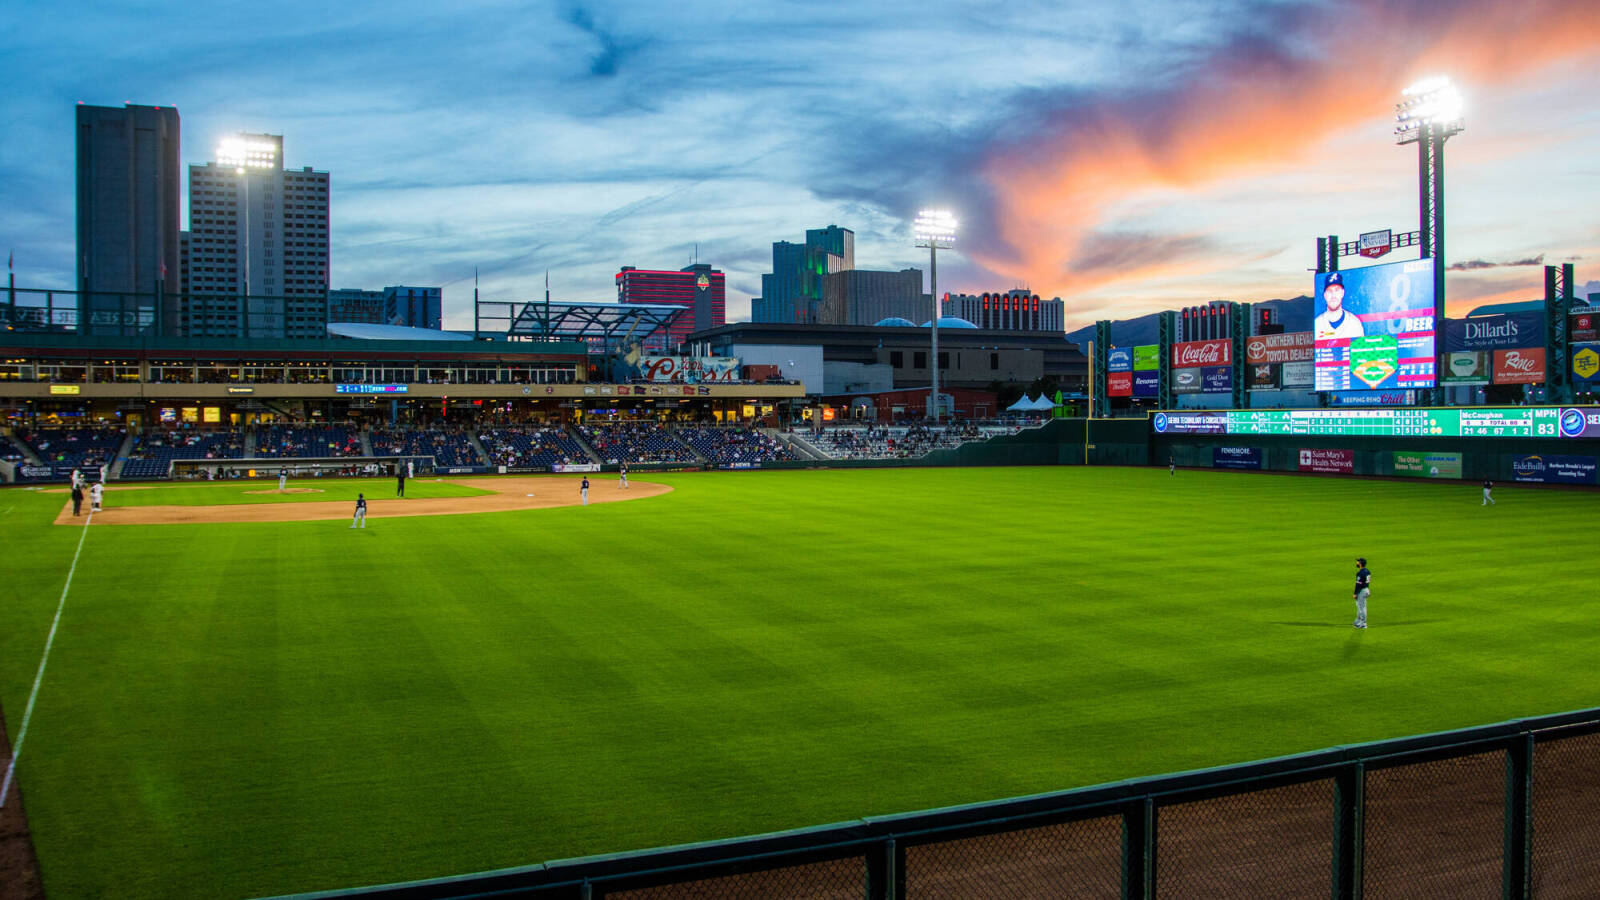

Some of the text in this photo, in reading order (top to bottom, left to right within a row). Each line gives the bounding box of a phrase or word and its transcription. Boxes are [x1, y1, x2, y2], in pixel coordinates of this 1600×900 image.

[1405, 317, 1434, 332] BEER
[1464, 320, 1518, 339] Dillard's
[1266, 334, 1295, 347] NORTHERN
[1266, 350, 1288, 361] TOYOTA
[1538, 424, 1554, 434] 83
[1326, 451, 1344, 459] Mary's
